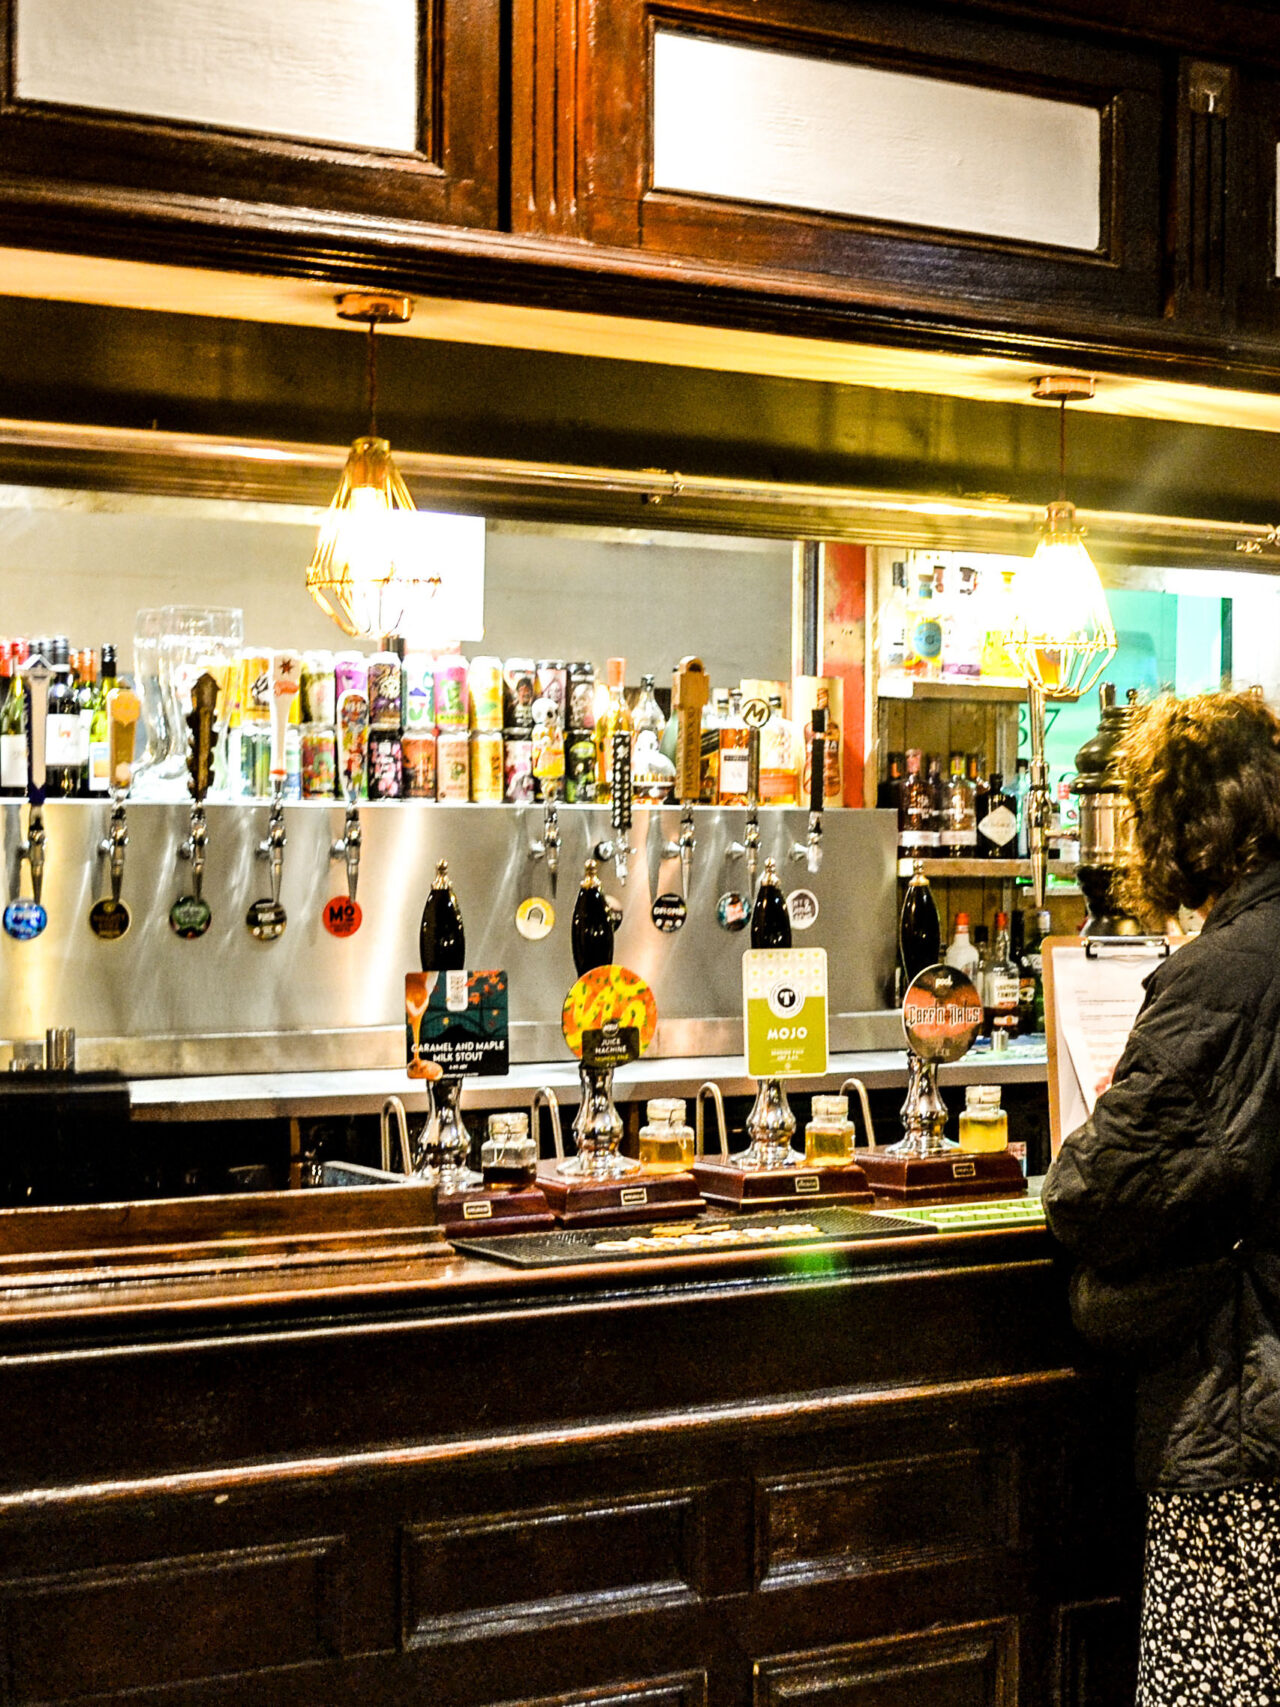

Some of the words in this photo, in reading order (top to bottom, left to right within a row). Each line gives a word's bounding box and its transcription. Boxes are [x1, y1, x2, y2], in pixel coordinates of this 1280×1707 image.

[766, 1026, 808, 1041] MOJO
[410, 1042, 453, 1053] CARAMEL
[454, 1041, 474, 1052] AND
[475, 1040, 505, 1051] MAPLE
[432, 1052, 454, 1063] MILK
[455, 1051, 484, 1062] STOUT
